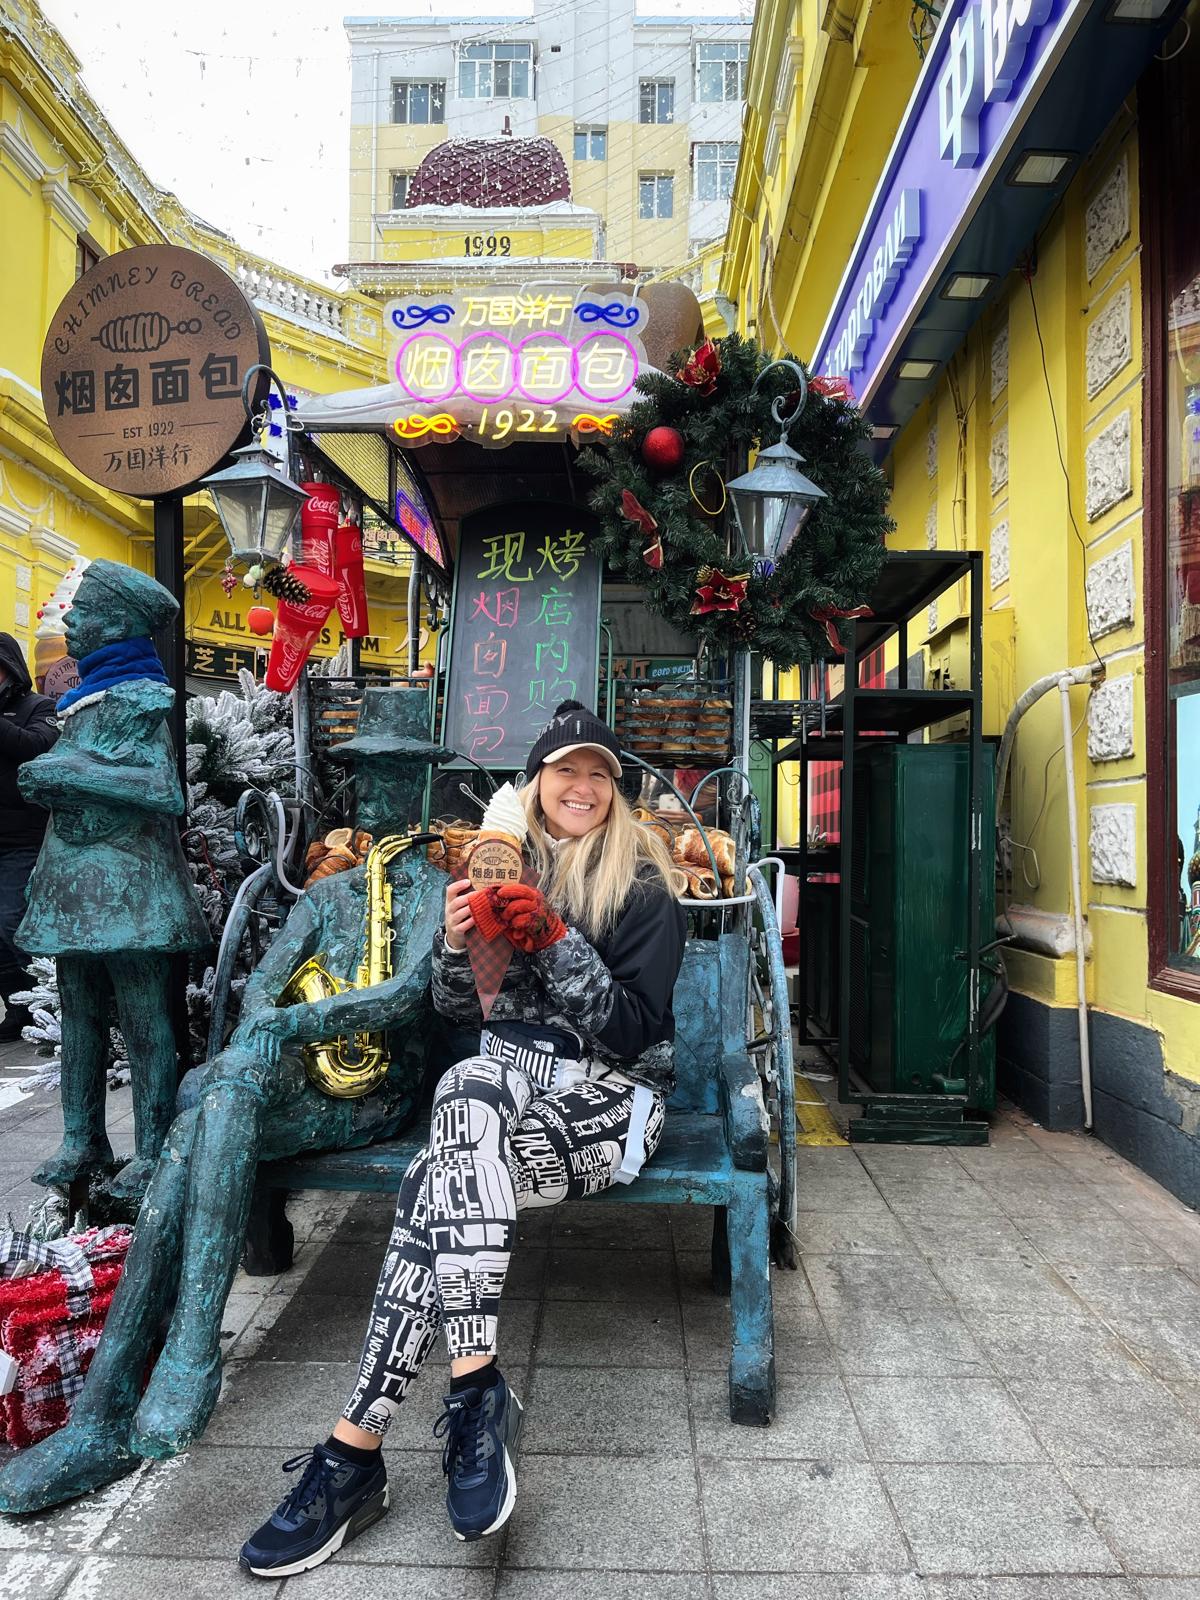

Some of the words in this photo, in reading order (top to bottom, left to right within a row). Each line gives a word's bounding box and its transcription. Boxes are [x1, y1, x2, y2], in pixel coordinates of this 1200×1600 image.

[54, 266, 159, 355] CHIMNEY
[170, 270, 241, 340] BREAD
[460, 294, 573, 328] 万国洋行
[405, 342, 628, 389] 烟囱面包
[54, 352, 242, 416] 烟囱面包
[123, 426, 143, 439] EST
[148, 421, 174, 436] 1922
[477, 408, 558, 440] 1922
[103, 443, 192, 472] 万国洋行
[477, 529, 586, 582] 现烤
[209, 610, 246, 631] ALL
[50, 661, 78, 687] CHIM
[193, 647, 244, 673] 芝士
[472, 867, 518, 879] 烟囱面包
